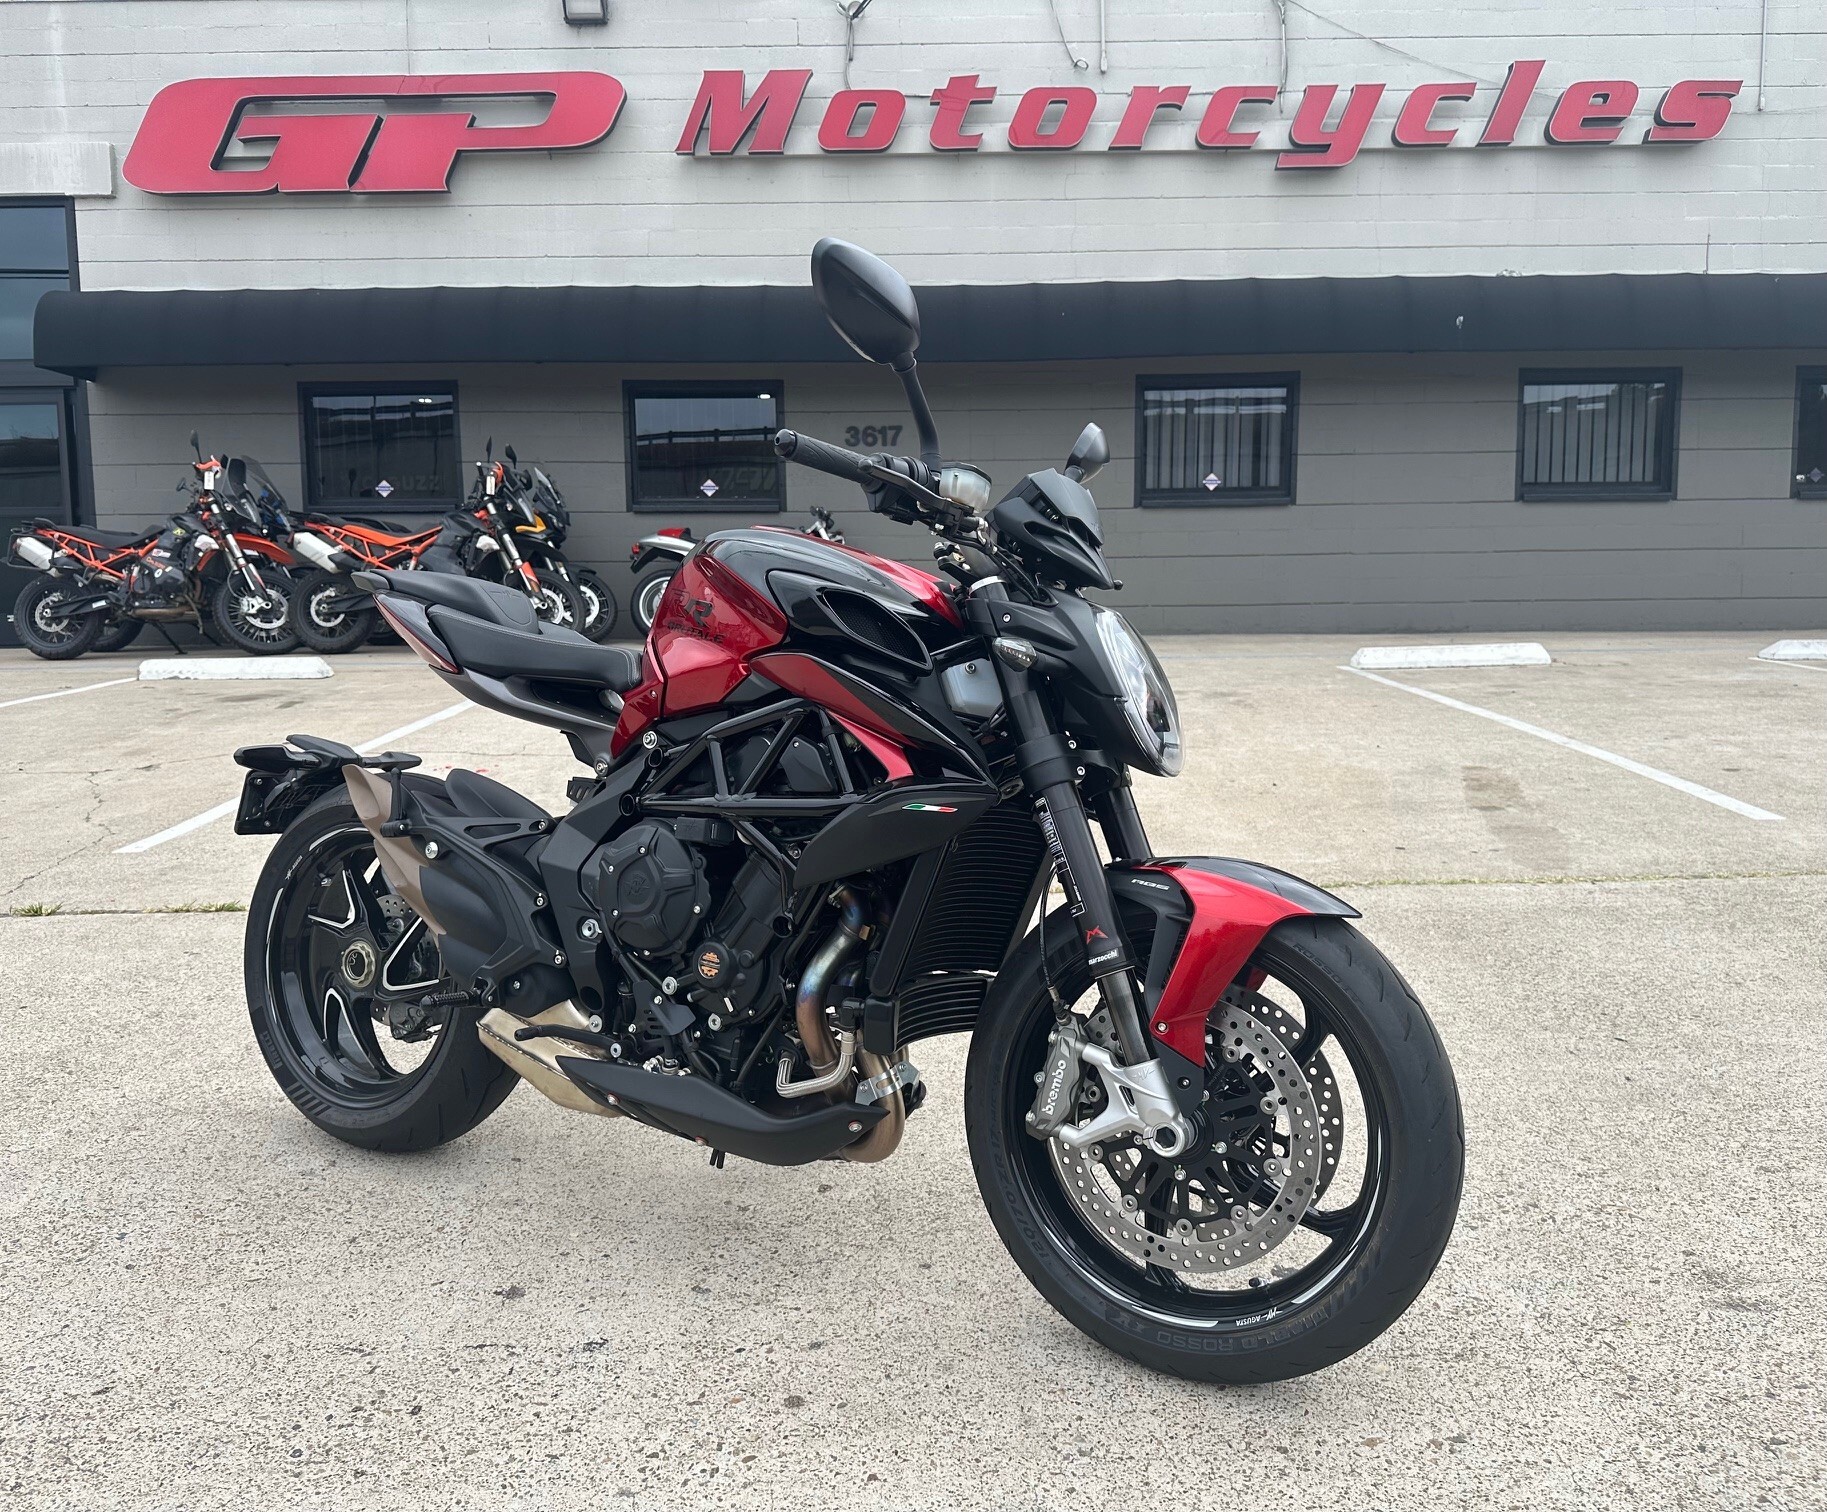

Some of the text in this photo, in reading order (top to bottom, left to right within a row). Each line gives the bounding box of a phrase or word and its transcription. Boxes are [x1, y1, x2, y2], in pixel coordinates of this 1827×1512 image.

[122, 60, 1743, 194] GP Motorcycles
[845, 425, 903, 447] 3617
[1041, 1060, 1067, 1116] brembo
[1235, 1314, 1262, 1327] AGUSTA
[1156, 1330, 1234, 1351] ROSSO
